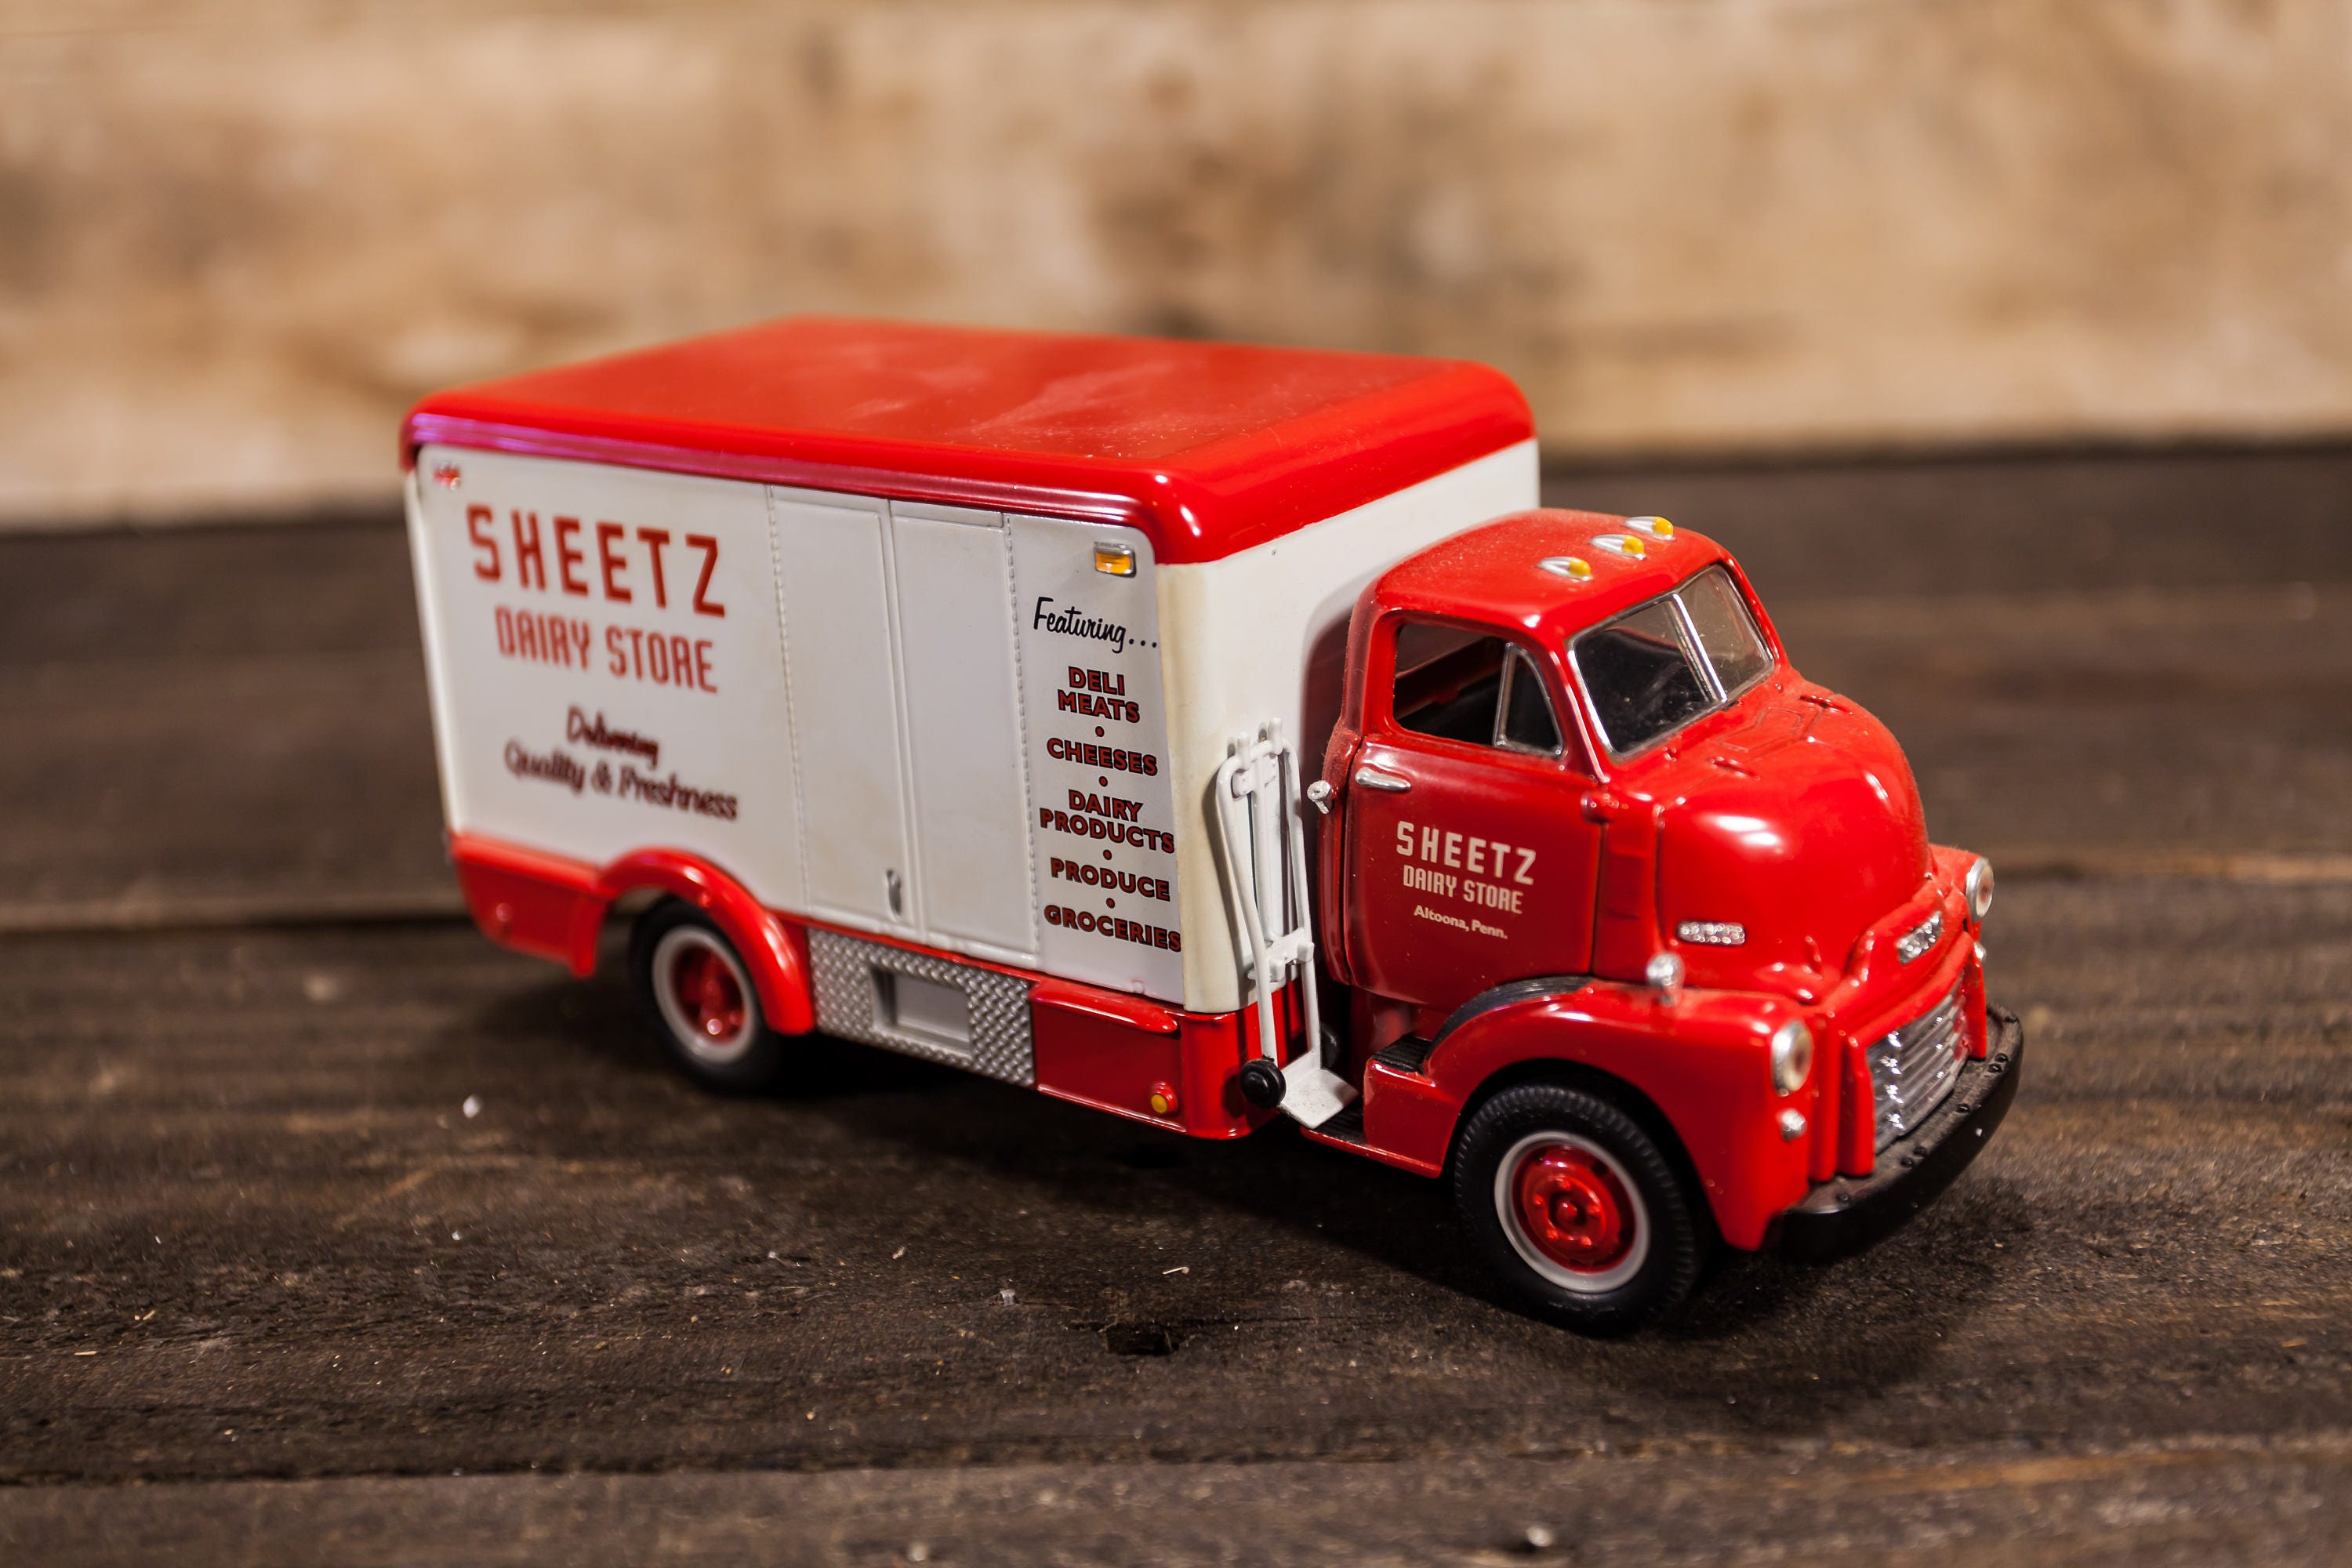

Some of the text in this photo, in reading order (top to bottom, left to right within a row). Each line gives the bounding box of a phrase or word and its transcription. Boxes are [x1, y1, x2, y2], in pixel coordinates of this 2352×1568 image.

[466, 503, 726, 619] SHEETZ
[494, 606, 718, 694] DAIRY STORE
[1068, 666, 1125, 696] DELI
[1057, 689, 1140, 723] MEATS
[504, 737, 738, 822] Quality & Freshness
[1047, 737, 1158, 776] CHEESES
[1068, 789, 1144, 822] DAIRY
[1039, 808, 1175, 854] PRODUCTS
[1396, 820, 1537, 886] SHEETZ
[1050, 857, 1171, 902] PRODUCE
[1403, 864, 1524, 914] DAIRY STORE
[1044, 904, 1181, 953] GROCERIES
[1414, 904, 1508, 939] Altoona, Penn.
